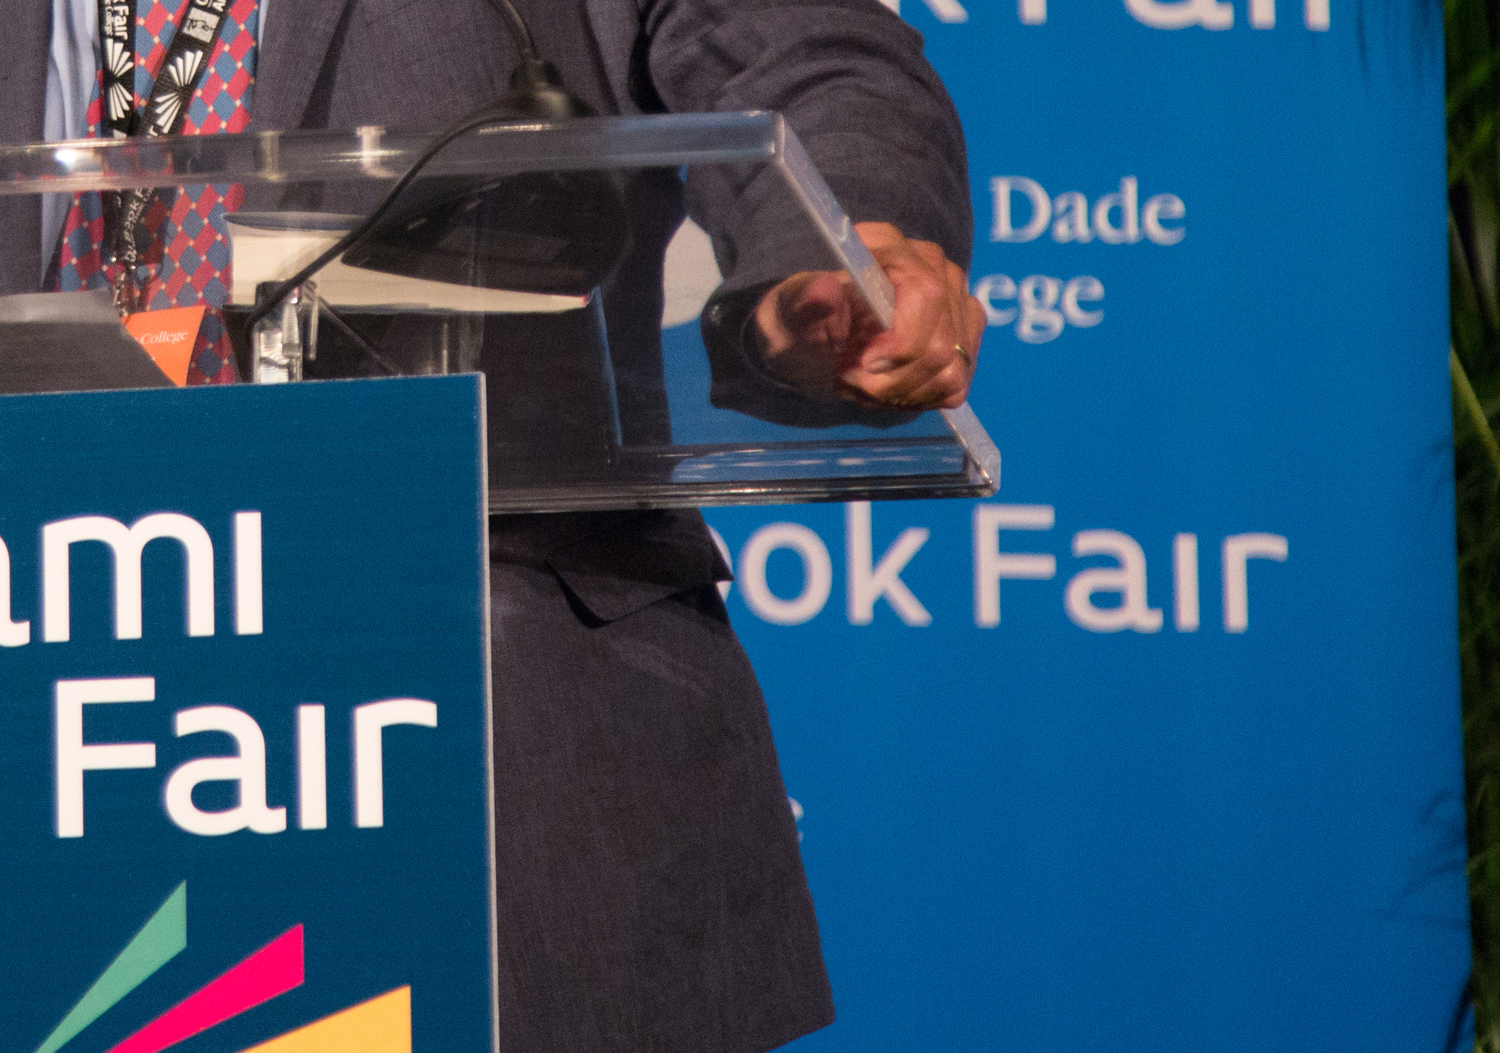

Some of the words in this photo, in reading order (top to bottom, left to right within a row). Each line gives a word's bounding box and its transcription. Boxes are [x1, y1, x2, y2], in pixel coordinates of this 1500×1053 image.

[113, 4, 130, 41] Fair
[989, 174, 1186, 247] Dade
[140, 330, 189, 345] College
[711, 501, 932, 627] ok
[972, 503, 1289, 634] Fair
[53, 675, 439, 839] Fair
